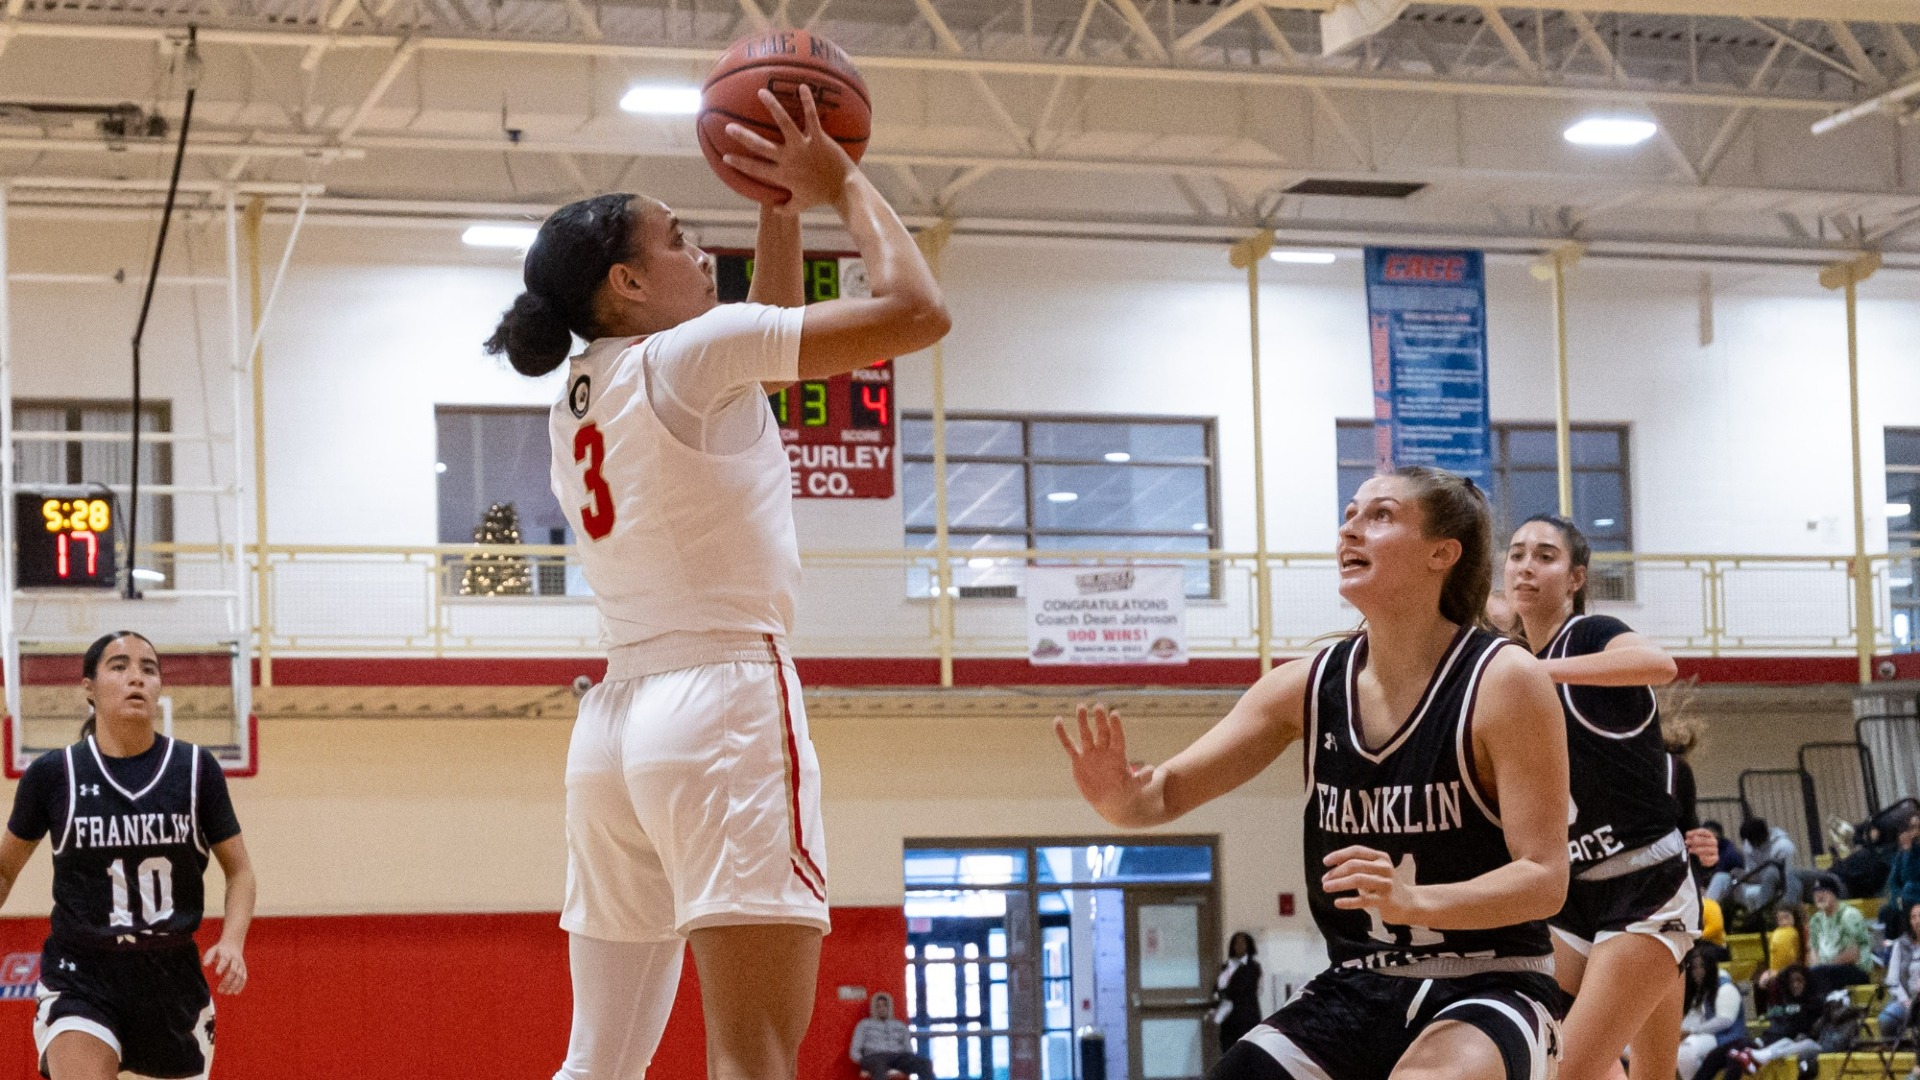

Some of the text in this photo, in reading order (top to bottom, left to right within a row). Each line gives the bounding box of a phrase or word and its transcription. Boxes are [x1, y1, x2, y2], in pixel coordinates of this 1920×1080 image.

[861, 385, 889, 427] 4
[573, 421, 616, 543] 3
[807, 472, 855, 496] CO.
[42, 498, 111, 533] 5:28
[56, 529, 100, 580] 17
[1035, 613, 1179, 626] Coach Dean Johnson
[1042, 598, 1170, 612] CONGRATULATIONS
[1102, 628, 1149, 642] WINS!
[1316, 780, 1464, 836] FRANKLIN
[73, 813, 193, 849] FRANKLIN
[106, 855, 175, 928] 10
